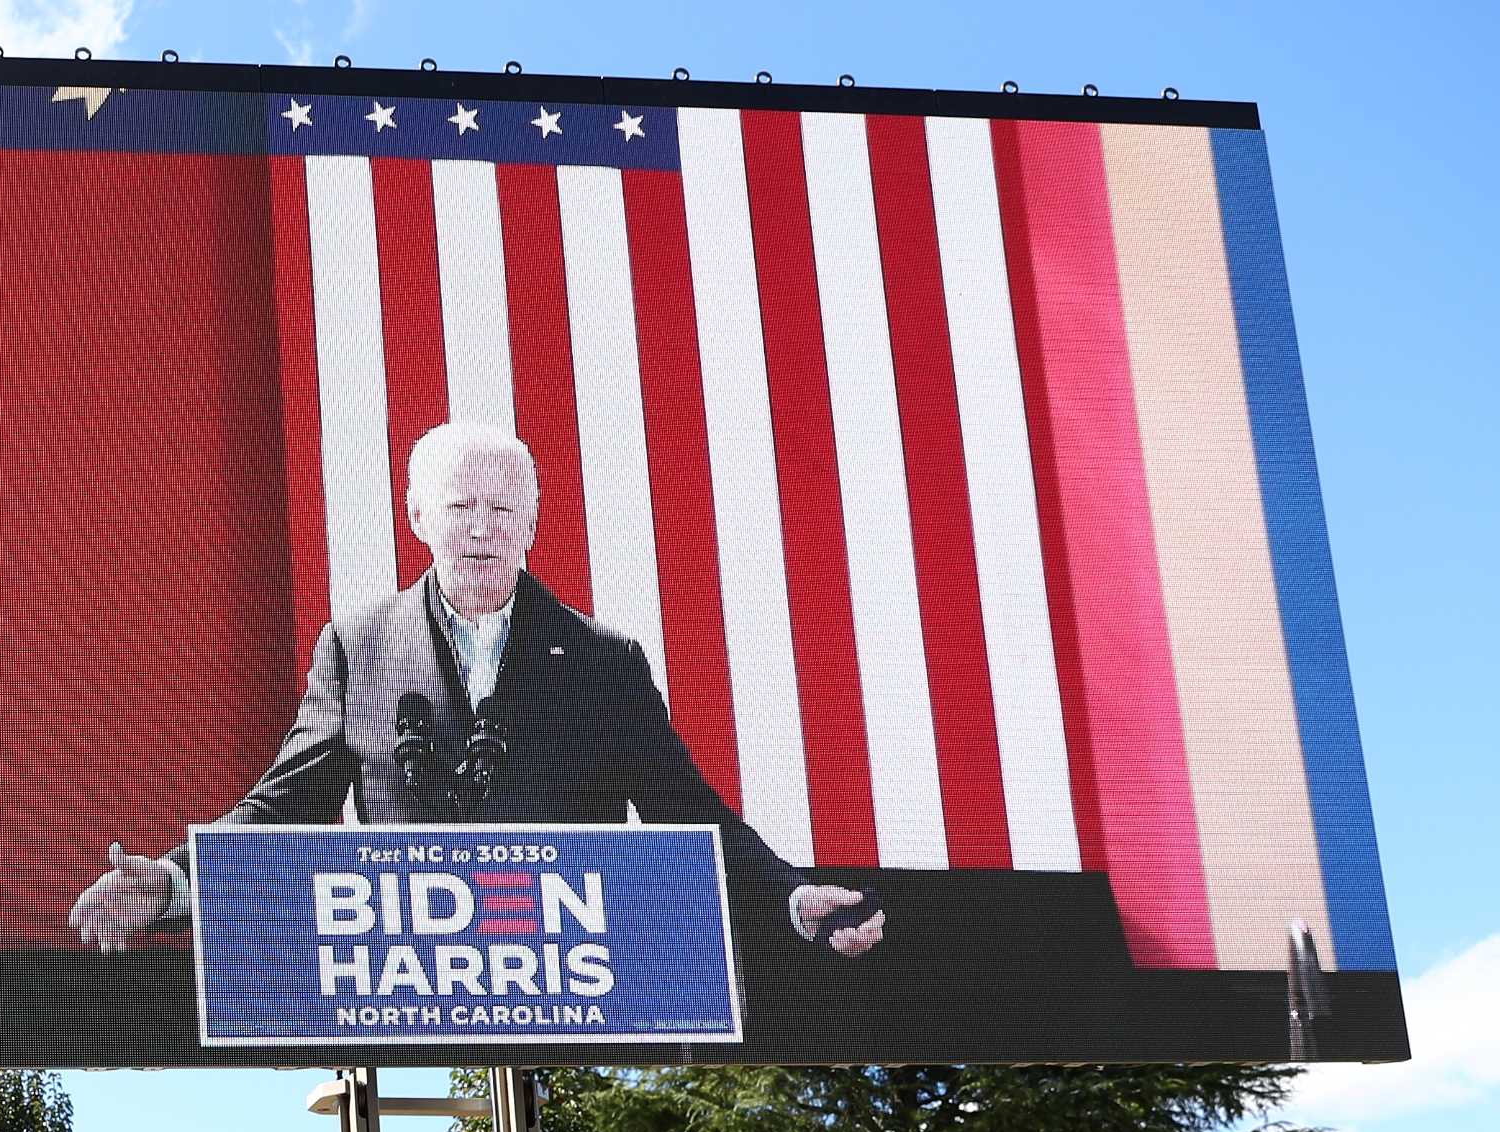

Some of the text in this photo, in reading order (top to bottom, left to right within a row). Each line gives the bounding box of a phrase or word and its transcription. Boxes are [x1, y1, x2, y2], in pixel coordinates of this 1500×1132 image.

[357, 845, 558, 863] Text NC to 30330
[312, 872, 607, 936] BIDEN
[318, 943, 617, 997] HARRIS
[336, 1005, 606, 1026] NORTH CAROLINA
